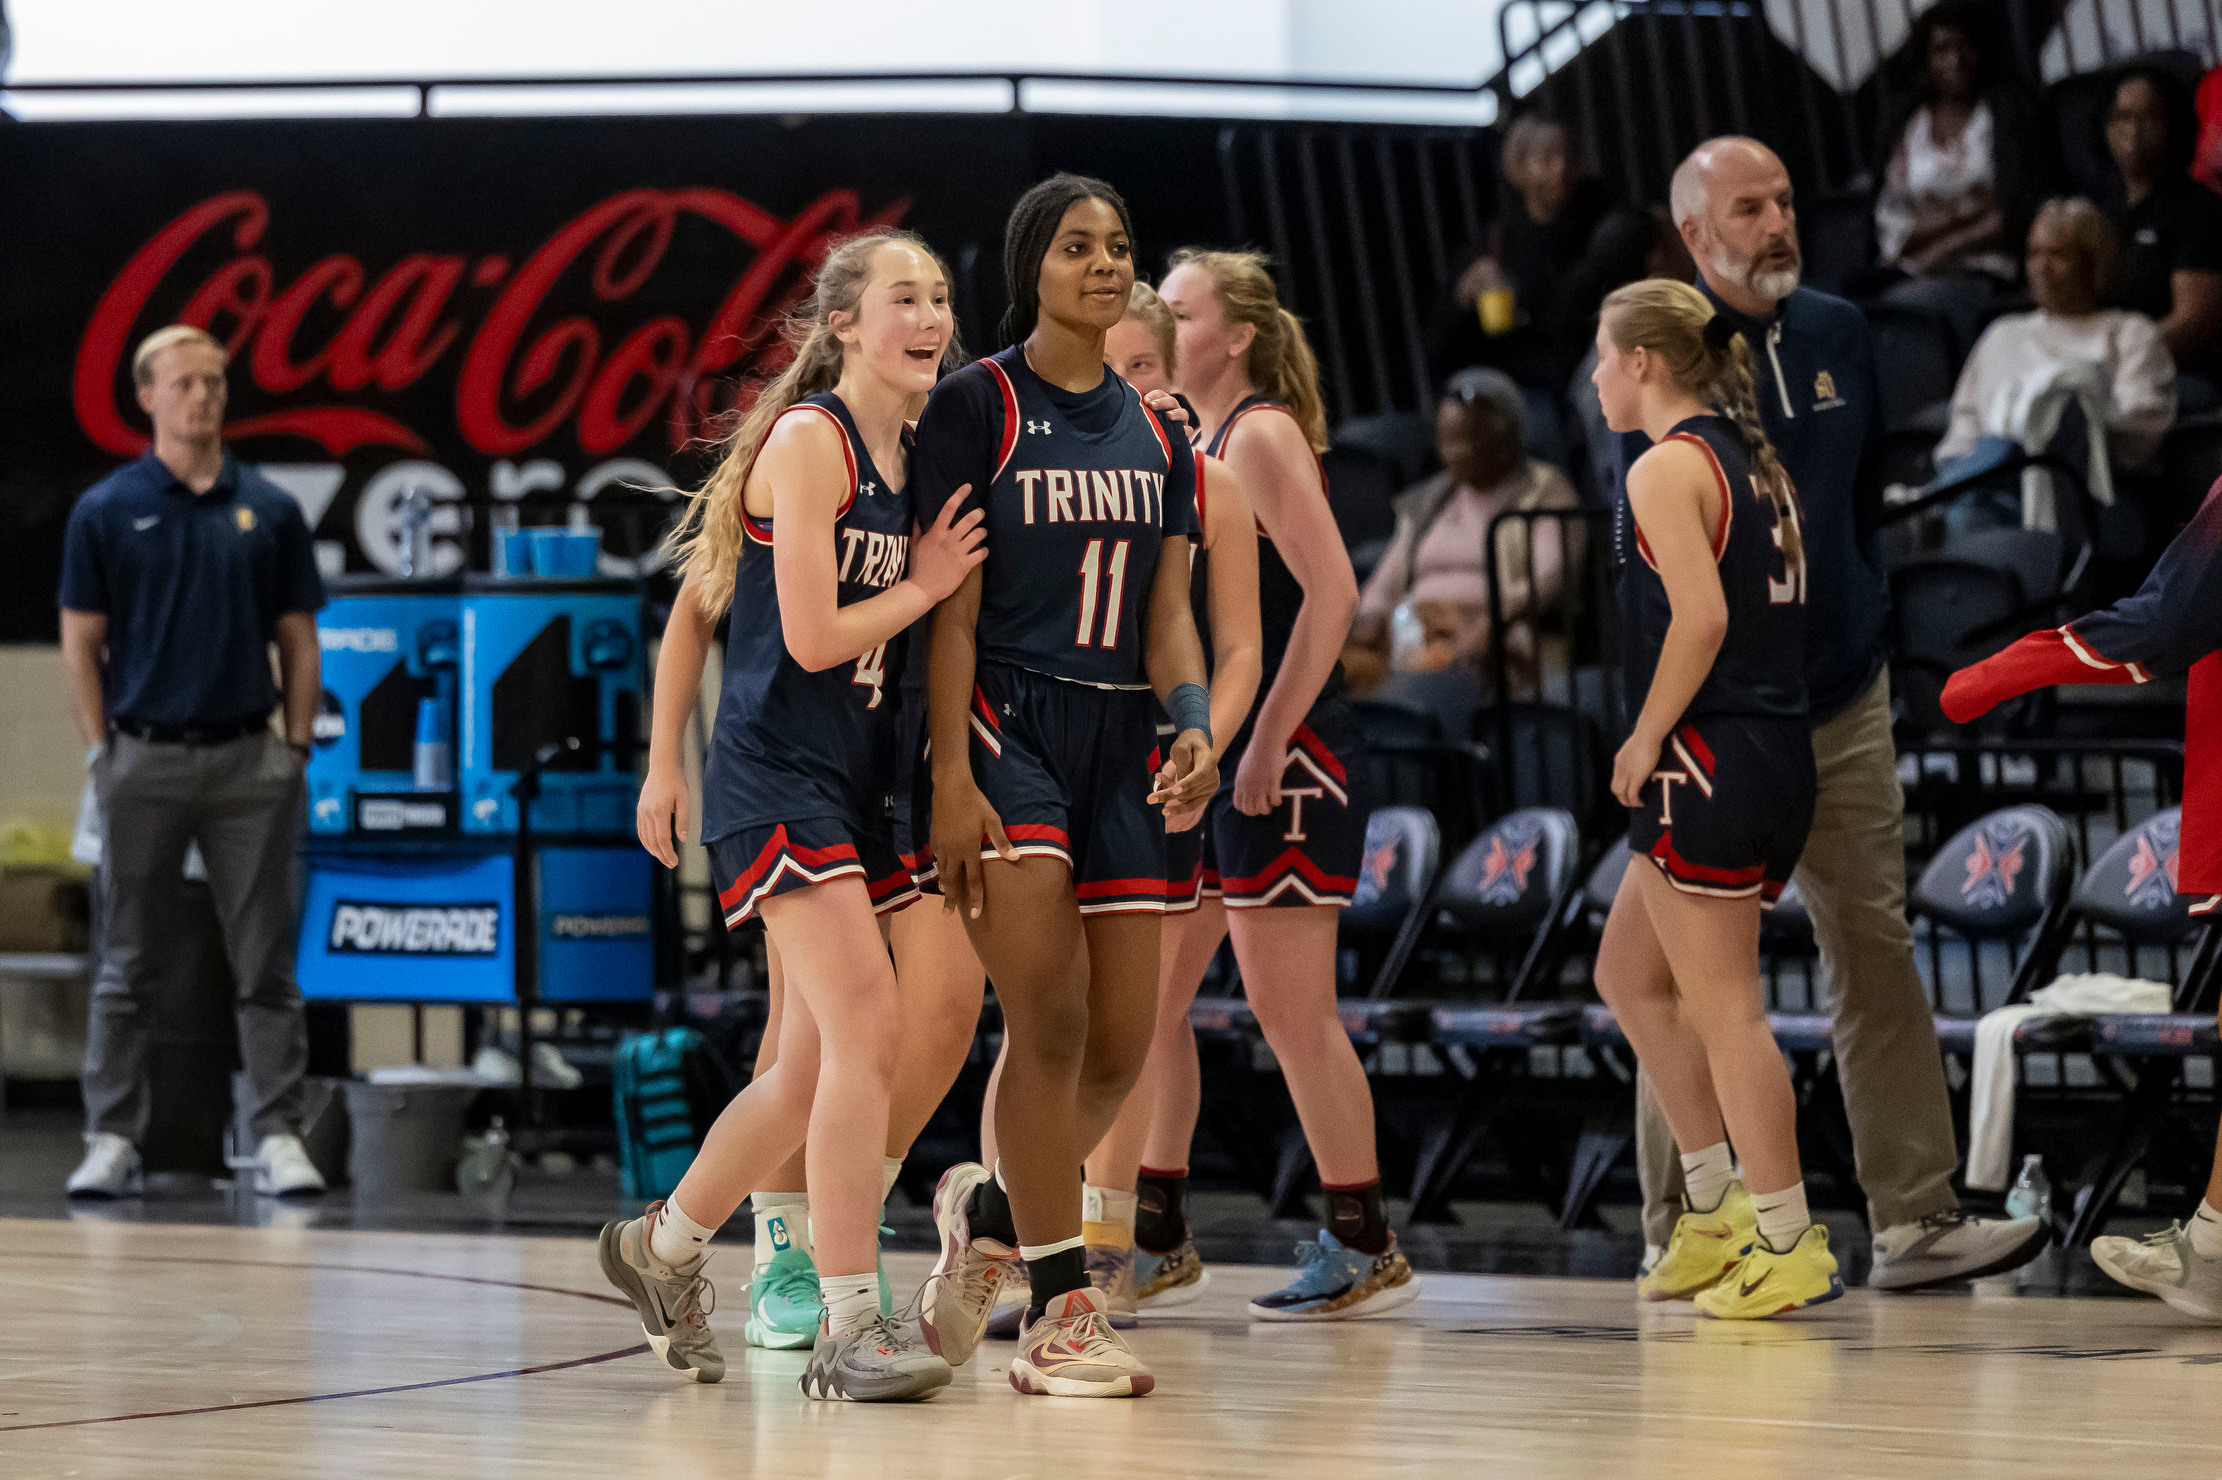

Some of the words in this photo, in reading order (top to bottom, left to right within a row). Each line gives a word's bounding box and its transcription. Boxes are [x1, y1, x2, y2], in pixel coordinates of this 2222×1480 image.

[1015, 469, 1164, 528] TRINITY
[1075, 538, 1131, 649] 11
[851, 639, 887, 711] 4
[1280, 786, 1324, 842] T
[1651, 771, 1688, 826] T
[332, 905, 498, 951] POWERADE
